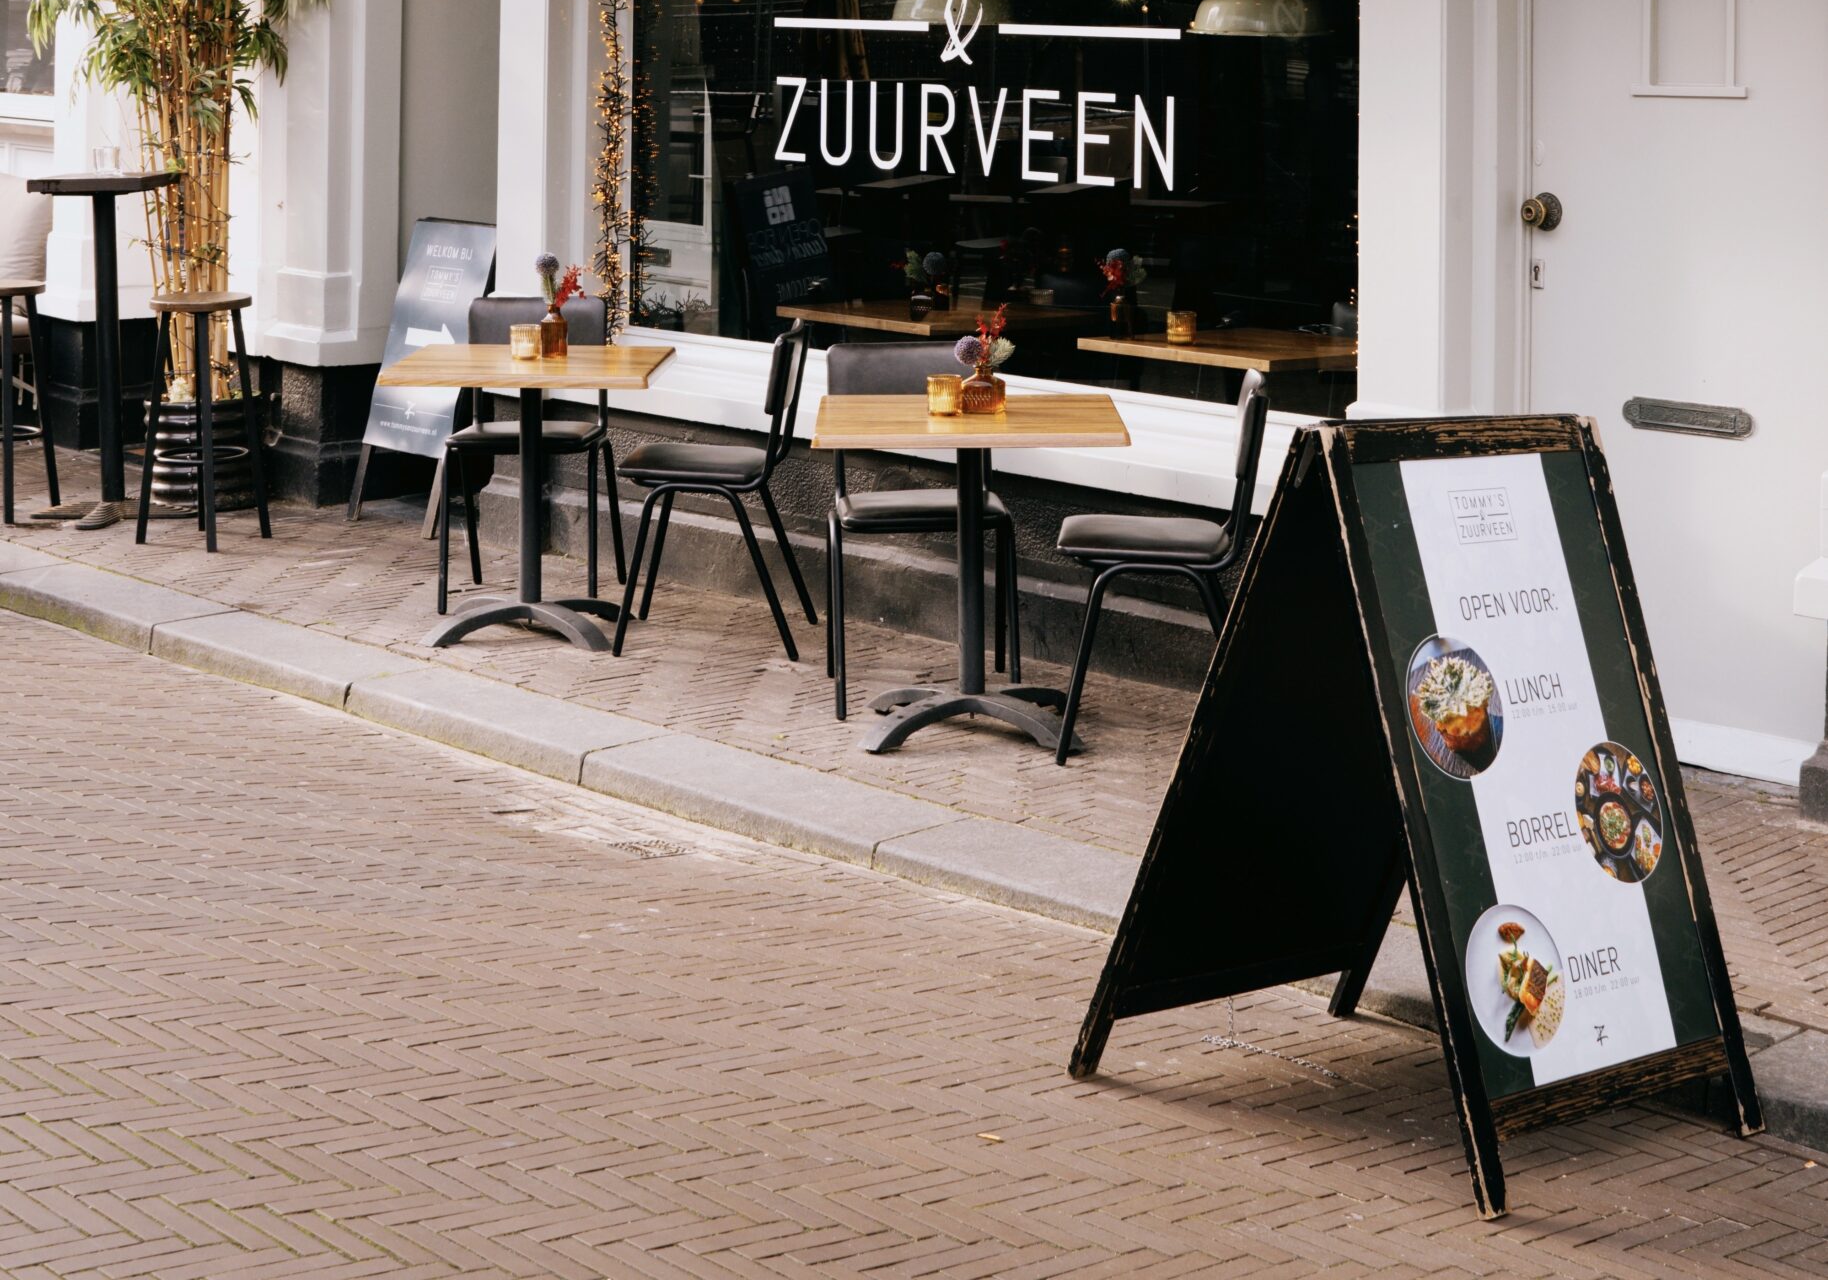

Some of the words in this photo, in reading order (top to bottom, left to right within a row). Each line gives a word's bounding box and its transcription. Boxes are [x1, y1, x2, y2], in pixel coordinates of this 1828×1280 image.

[773, 75, 1176, 193] ZUURVEEN
[426, 244, 460, 259] WELKOM
[460, 247, 474, 261] BIJ
[1453, 493, 1505, 510] TOMMY'S
[1459, 521, 1513, 539] ZUURVEEN
[1459, 591, 1507, 621] OPEN
[1508, 587, 1559, 615] VOOR:
[1504, 672, 1564, 705] LUNCH
[1506, 810, 1577, 848] BORREL
[1567, 945, 1622, 983] DINER
